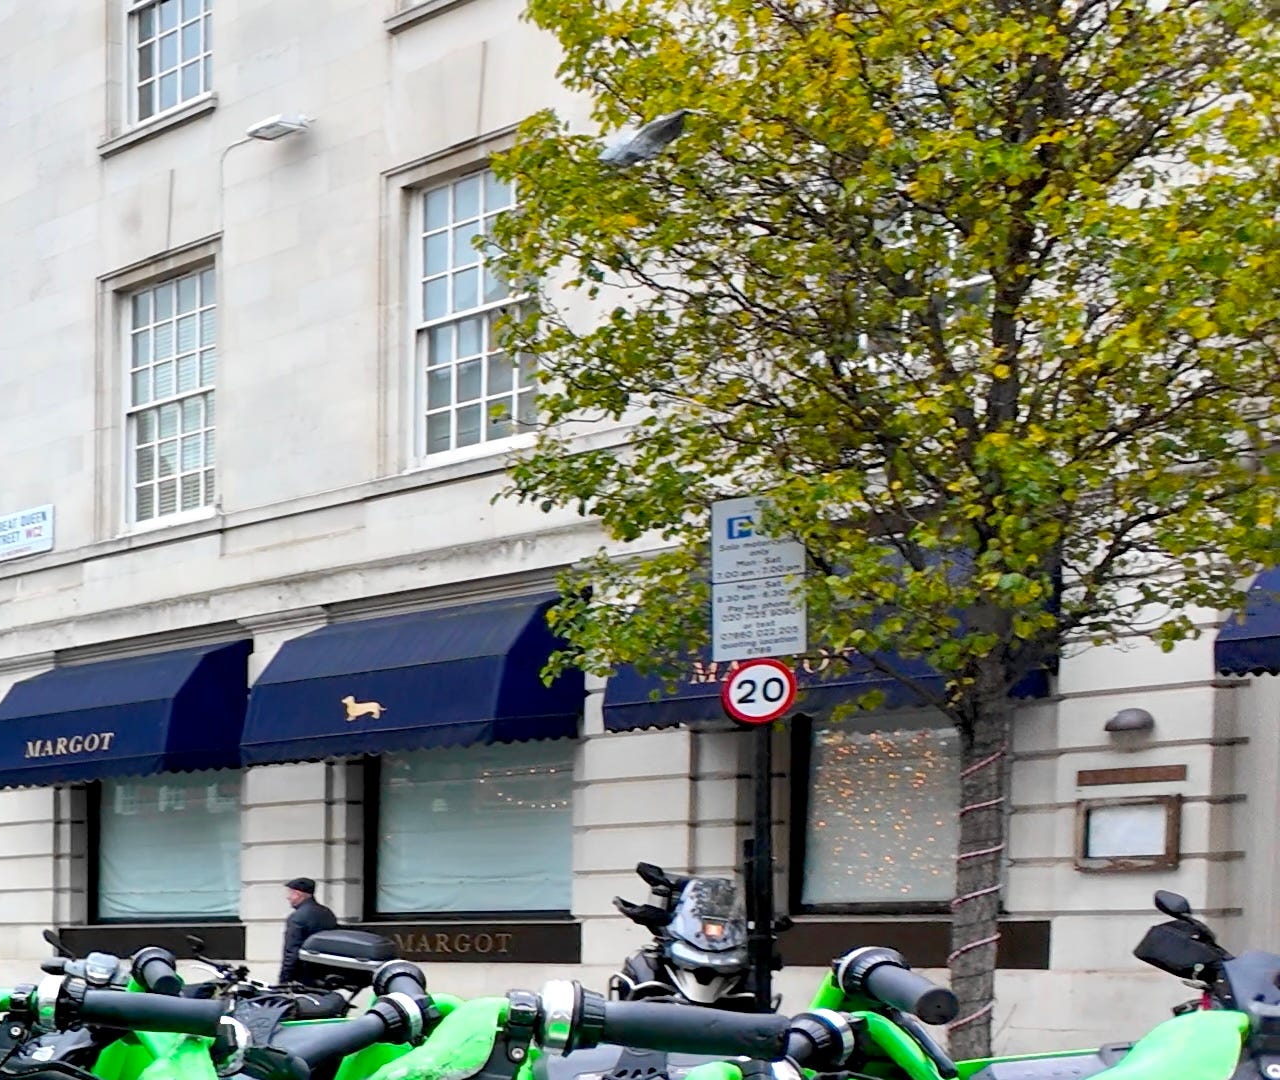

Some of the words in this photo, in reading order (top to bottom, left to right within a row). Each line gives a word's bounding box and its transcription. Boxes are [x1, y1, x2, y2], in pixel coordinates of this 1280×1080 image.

[737, 677, 785, 704] 20
[24, 732, 115, 758] MARGOT
[394, 933, 513, 953] MARGOT
